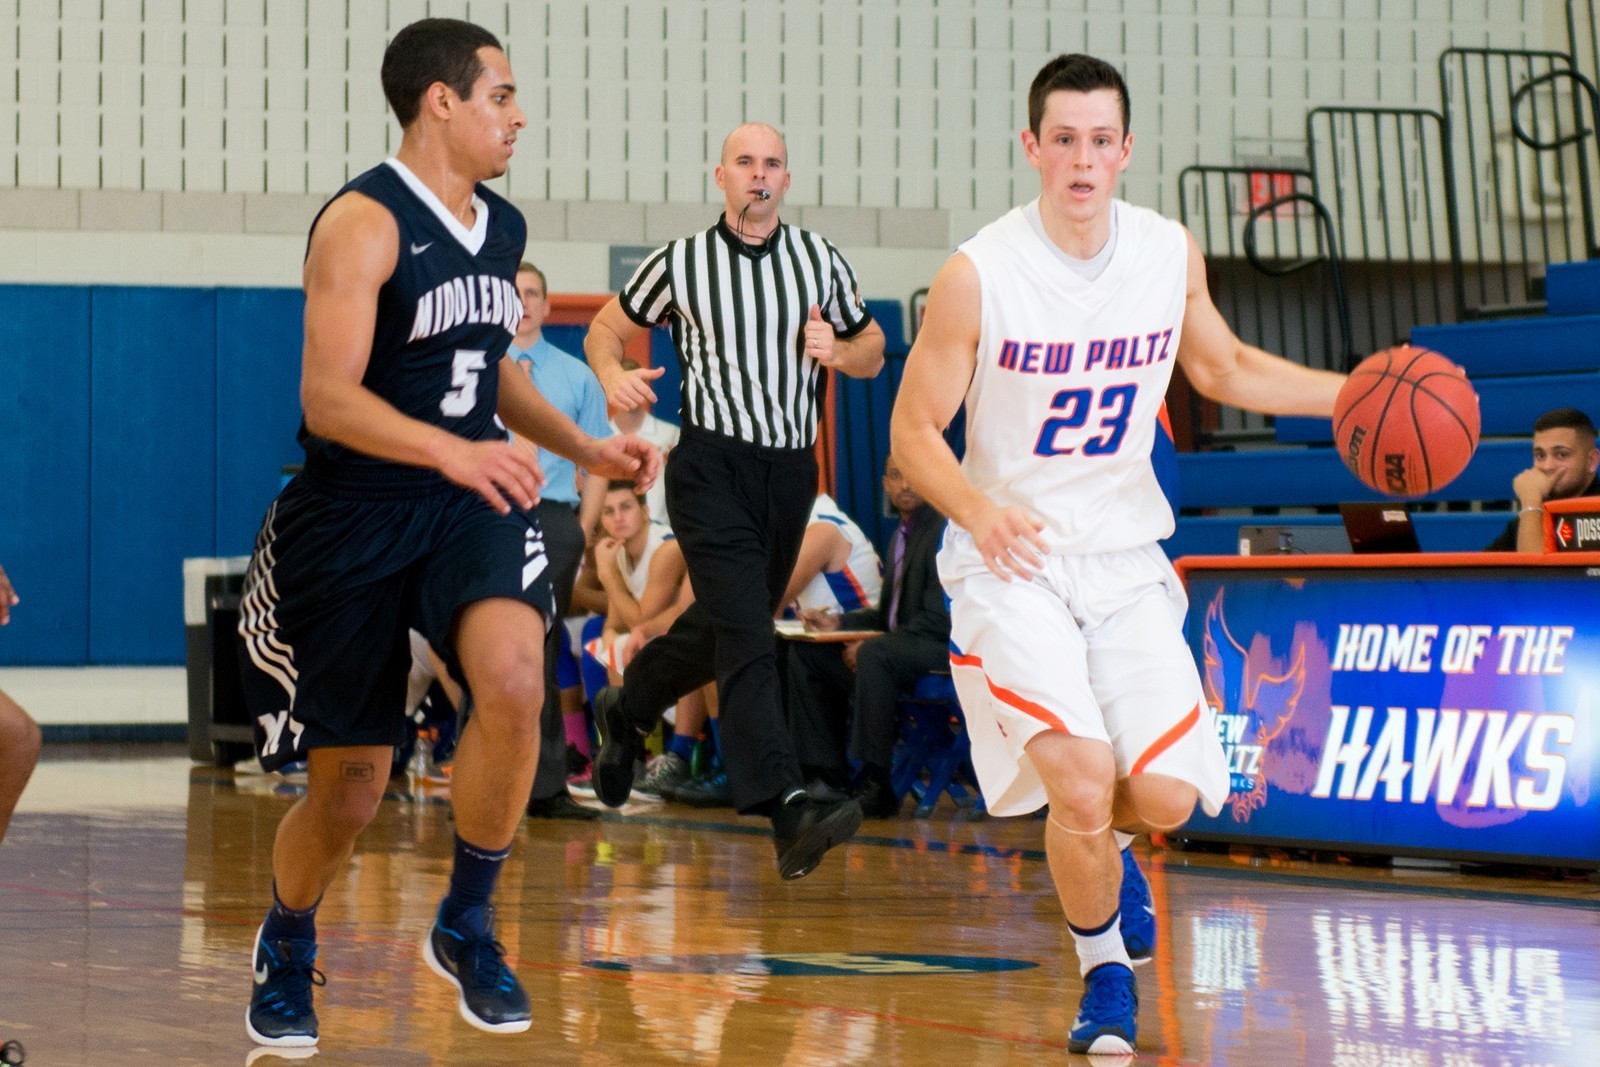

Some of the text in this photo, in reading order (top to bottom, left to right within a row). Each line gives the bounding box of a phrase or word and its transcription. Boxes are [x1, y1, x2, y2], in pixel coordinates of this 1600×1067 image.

[439, 349, 487, 417] 5
[998, 327, 1173, 375] NEW PALTZ
[1033, 382, 1138, 457] 23
[1331, 624, 1575, 675] HOME OF THE
[1310, 705, 1575, 811] HAWKS
